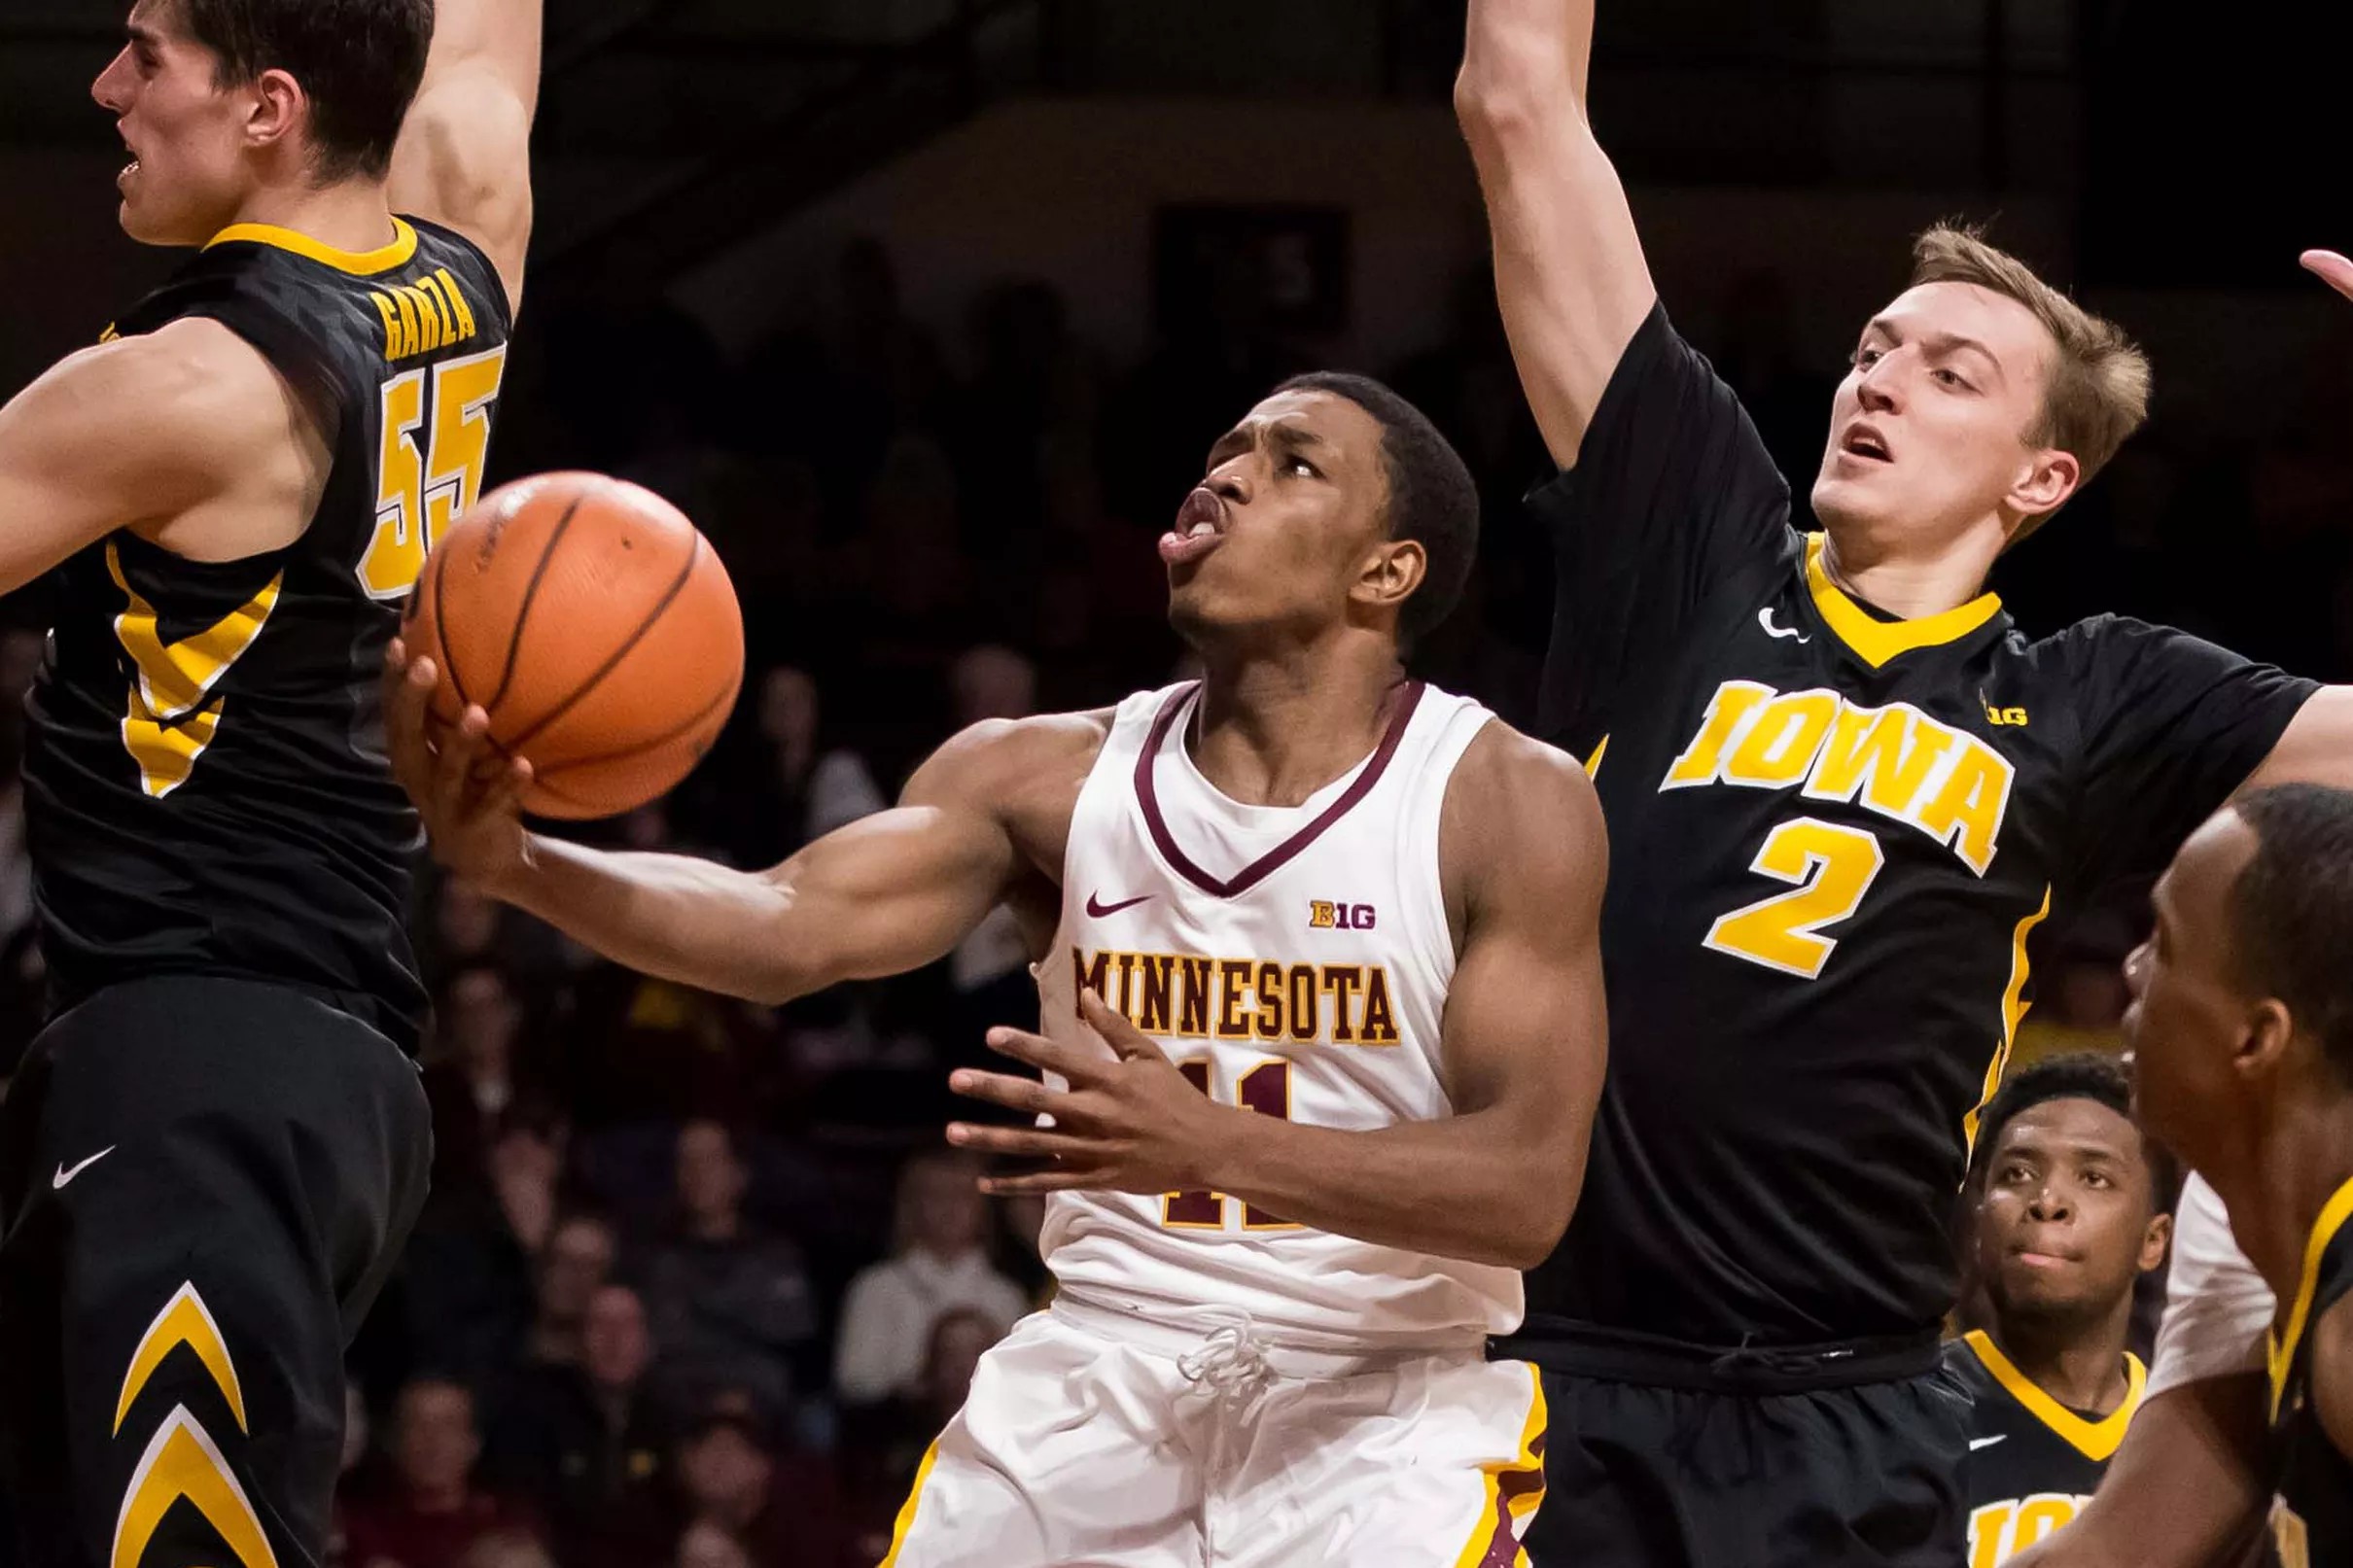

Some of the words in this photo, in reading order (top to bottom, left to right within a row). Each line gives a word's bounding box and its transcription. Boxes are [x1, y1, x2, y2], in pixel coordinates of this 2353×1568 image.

[370, 268, 475, 361] GARZA
[355, 340, 508, 600] 55
[1658, 680, 2017, 879] IOWA
[1702, 817, 1884, 980] 2
[1072, 946, 1401, 1047] MINNESOTA
